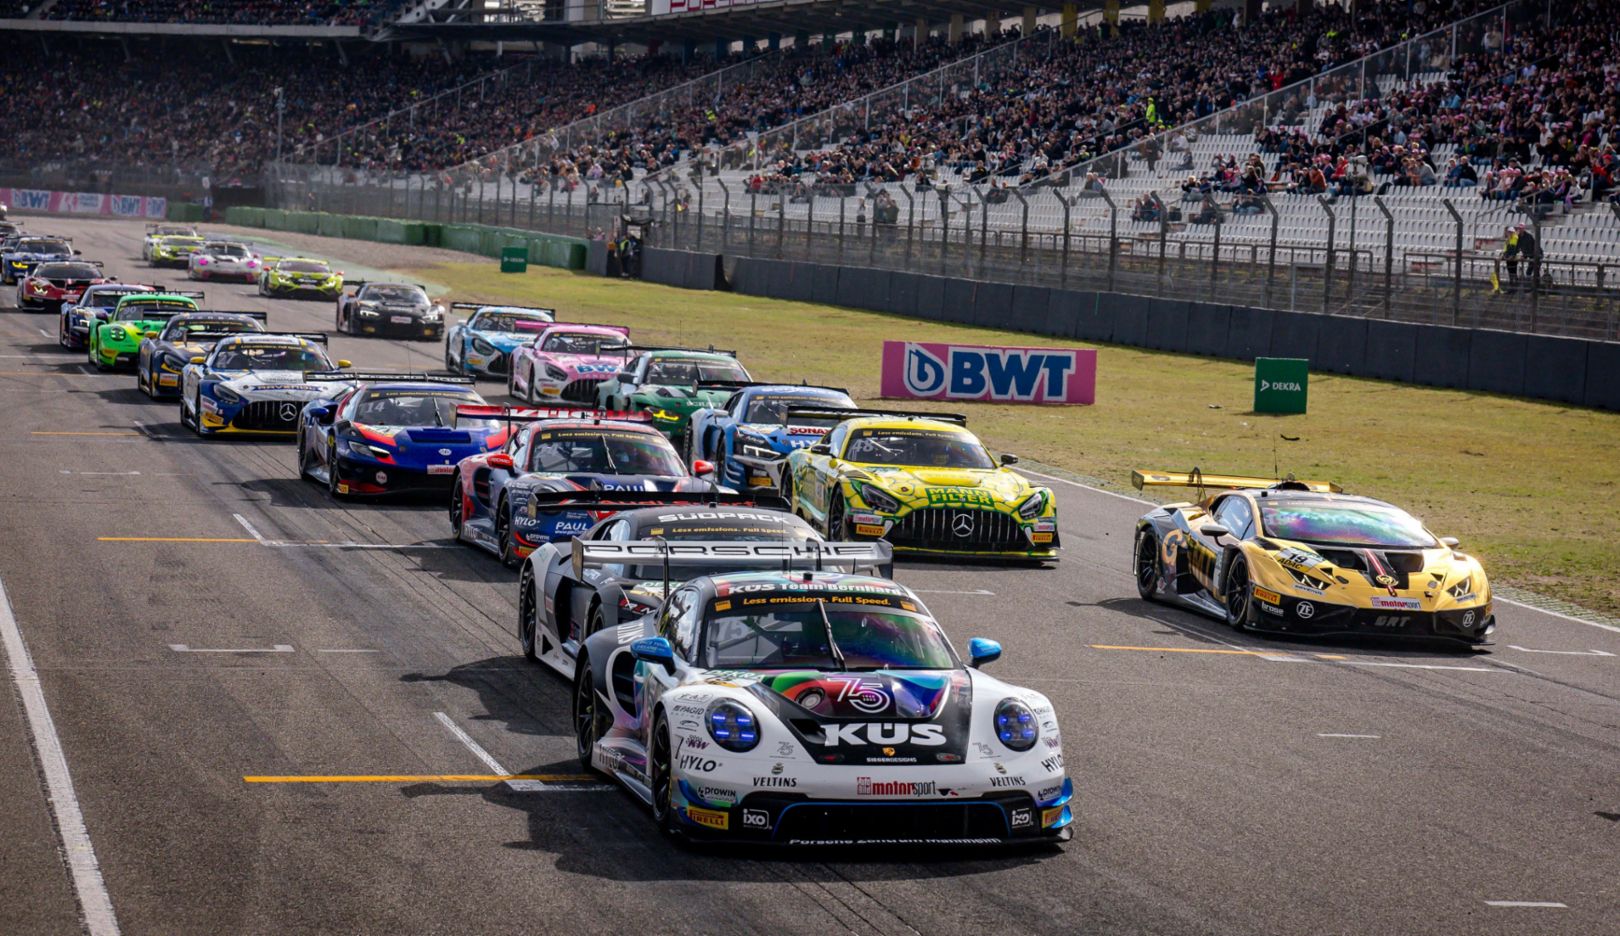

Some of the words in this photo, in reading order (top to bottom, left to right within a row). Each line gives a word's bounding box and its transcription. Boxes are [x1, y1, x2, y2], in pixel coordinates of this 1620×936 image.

[948, 347, 1073, 400] BWT
[1272, 382, 1301, 391] DEKRA
[366, 402, 385, 413] 14
[852, 438, 874, 452] 48
[929, 487, 988, 496] MANN
[931, 493, 995, 505] FILTER
[514, 516, 536, 527] HYLO
[555, 521, 589, 531] PAUL
[583, 544, 877, 557] PORSCHE
[1277, 557, 1304, 571] ADAC
[1289, 553, 1308, 564] 19
[780, 583, 824, 592] Team
[743, 597, 767, 605] Less
[831, 597, 853, 605] Full
[855, 597, 892, 606] Speed.
[1255, 588, 1278, 603] PIRELLI
[1374, 616, 1411, 627] GRT
[827, 677, 891, 714] 75
[820, 722, 947, 747] KÜS
[680, 754, 717, 772] HYLO
[753, 776, 798, 788] VELTINS
[990, 776, 1026, 788] VELTINS
[872, 780, 937, 797] motorsport
[689, 809, 724, 826] PIRELLI
[743, 808, 766, 826] ixo
[1011, 809, 1030, 826] ixo
